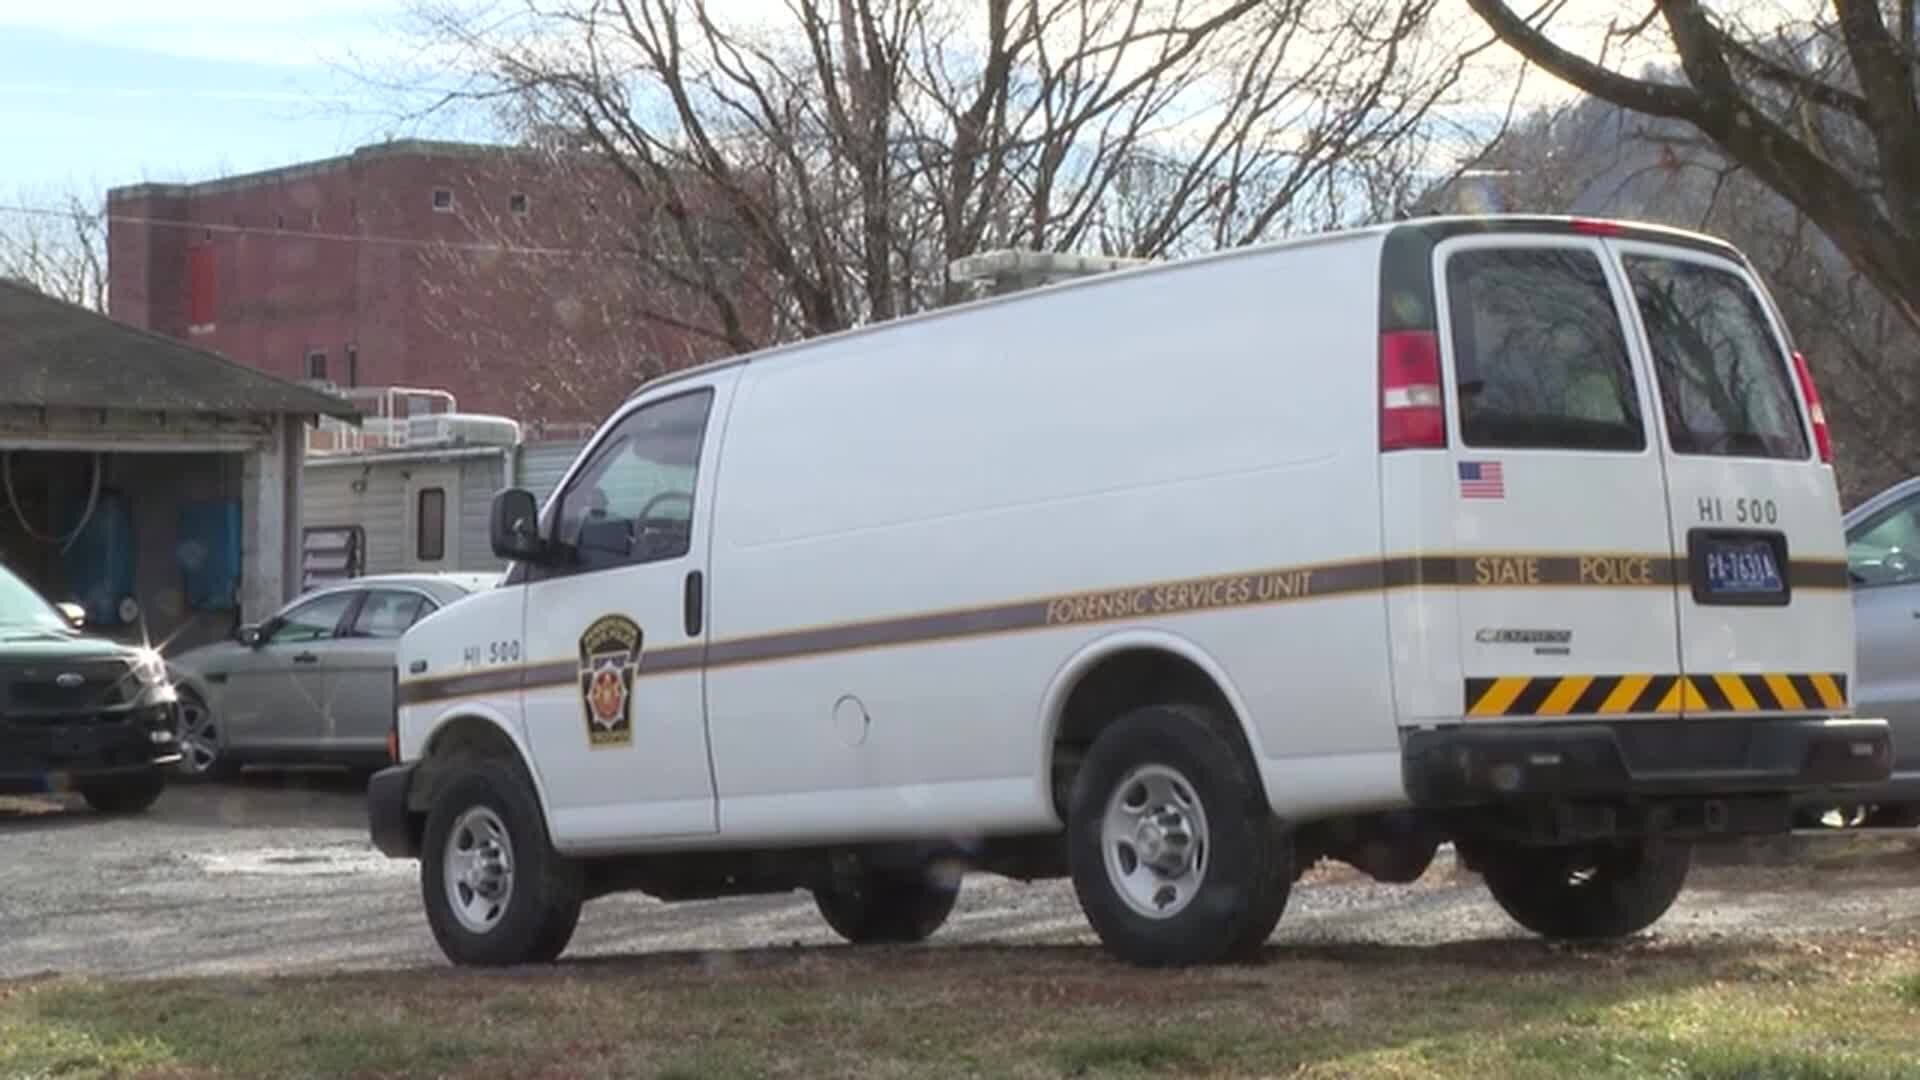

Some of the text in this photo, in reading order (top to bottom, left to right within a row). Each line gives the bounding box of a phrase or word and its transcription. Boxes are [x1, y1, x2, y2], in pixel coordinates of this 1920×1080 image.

[1697, 498, 1776, 524] HI 500
[1475, 557, 1651, 585] STATE POLICE
[1046, 571, 1312, 625] FORENSIC SERVICES UNIT
[489, 640, 519, 663] 500
